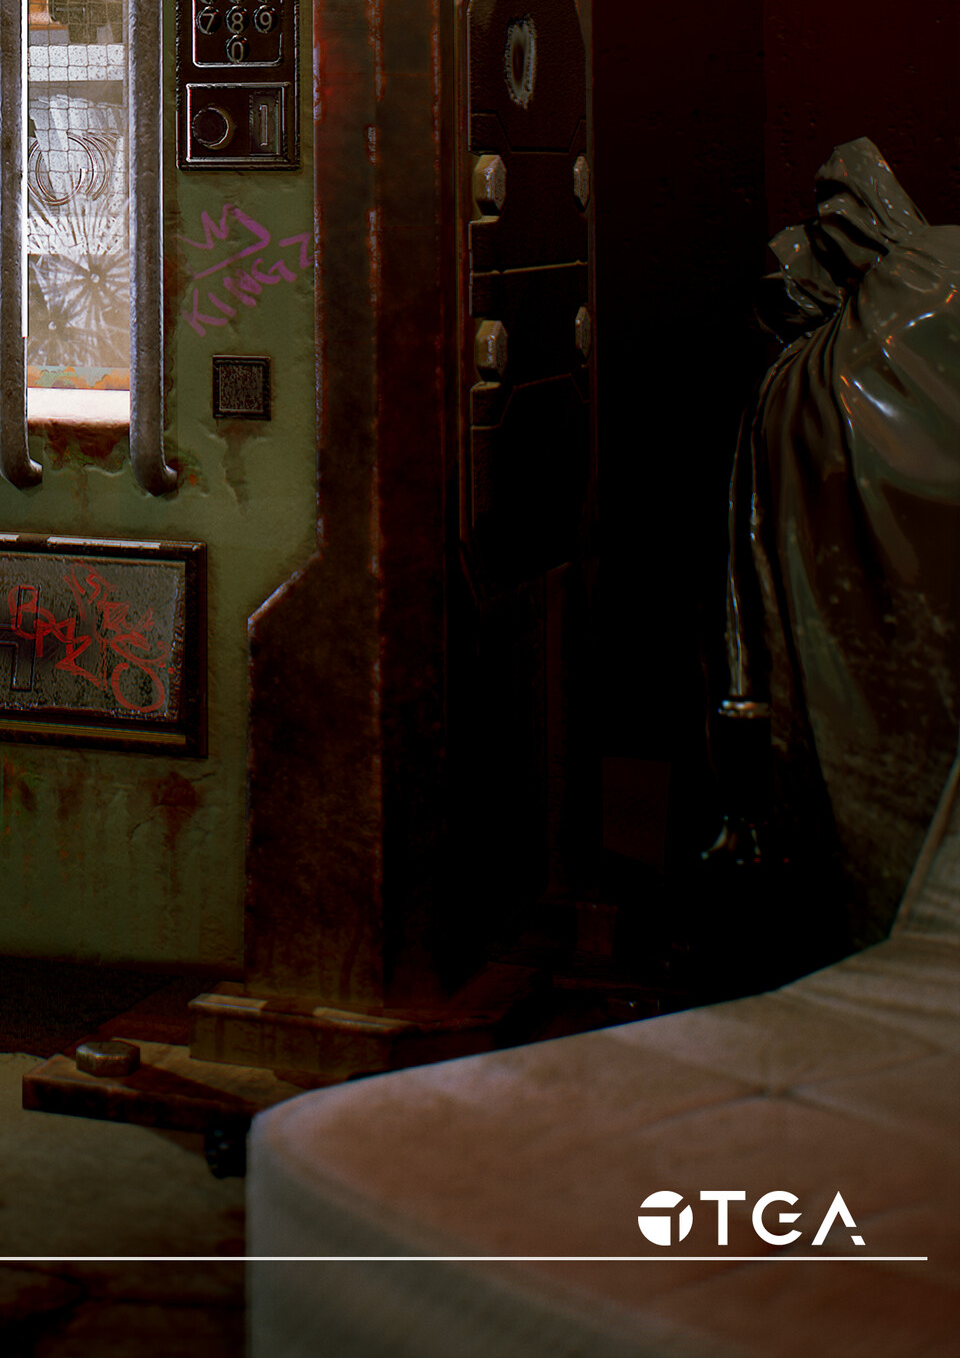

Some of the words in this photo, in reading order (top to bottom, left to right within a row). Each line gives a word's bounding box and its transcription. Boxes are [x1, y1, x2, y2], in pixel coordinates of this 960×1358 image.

[202, 13, 215, 32] 7
[231, 12, 244, 33] 8
[260, 11, 272, 33] 9
[231, 41, 244, 62] 0
